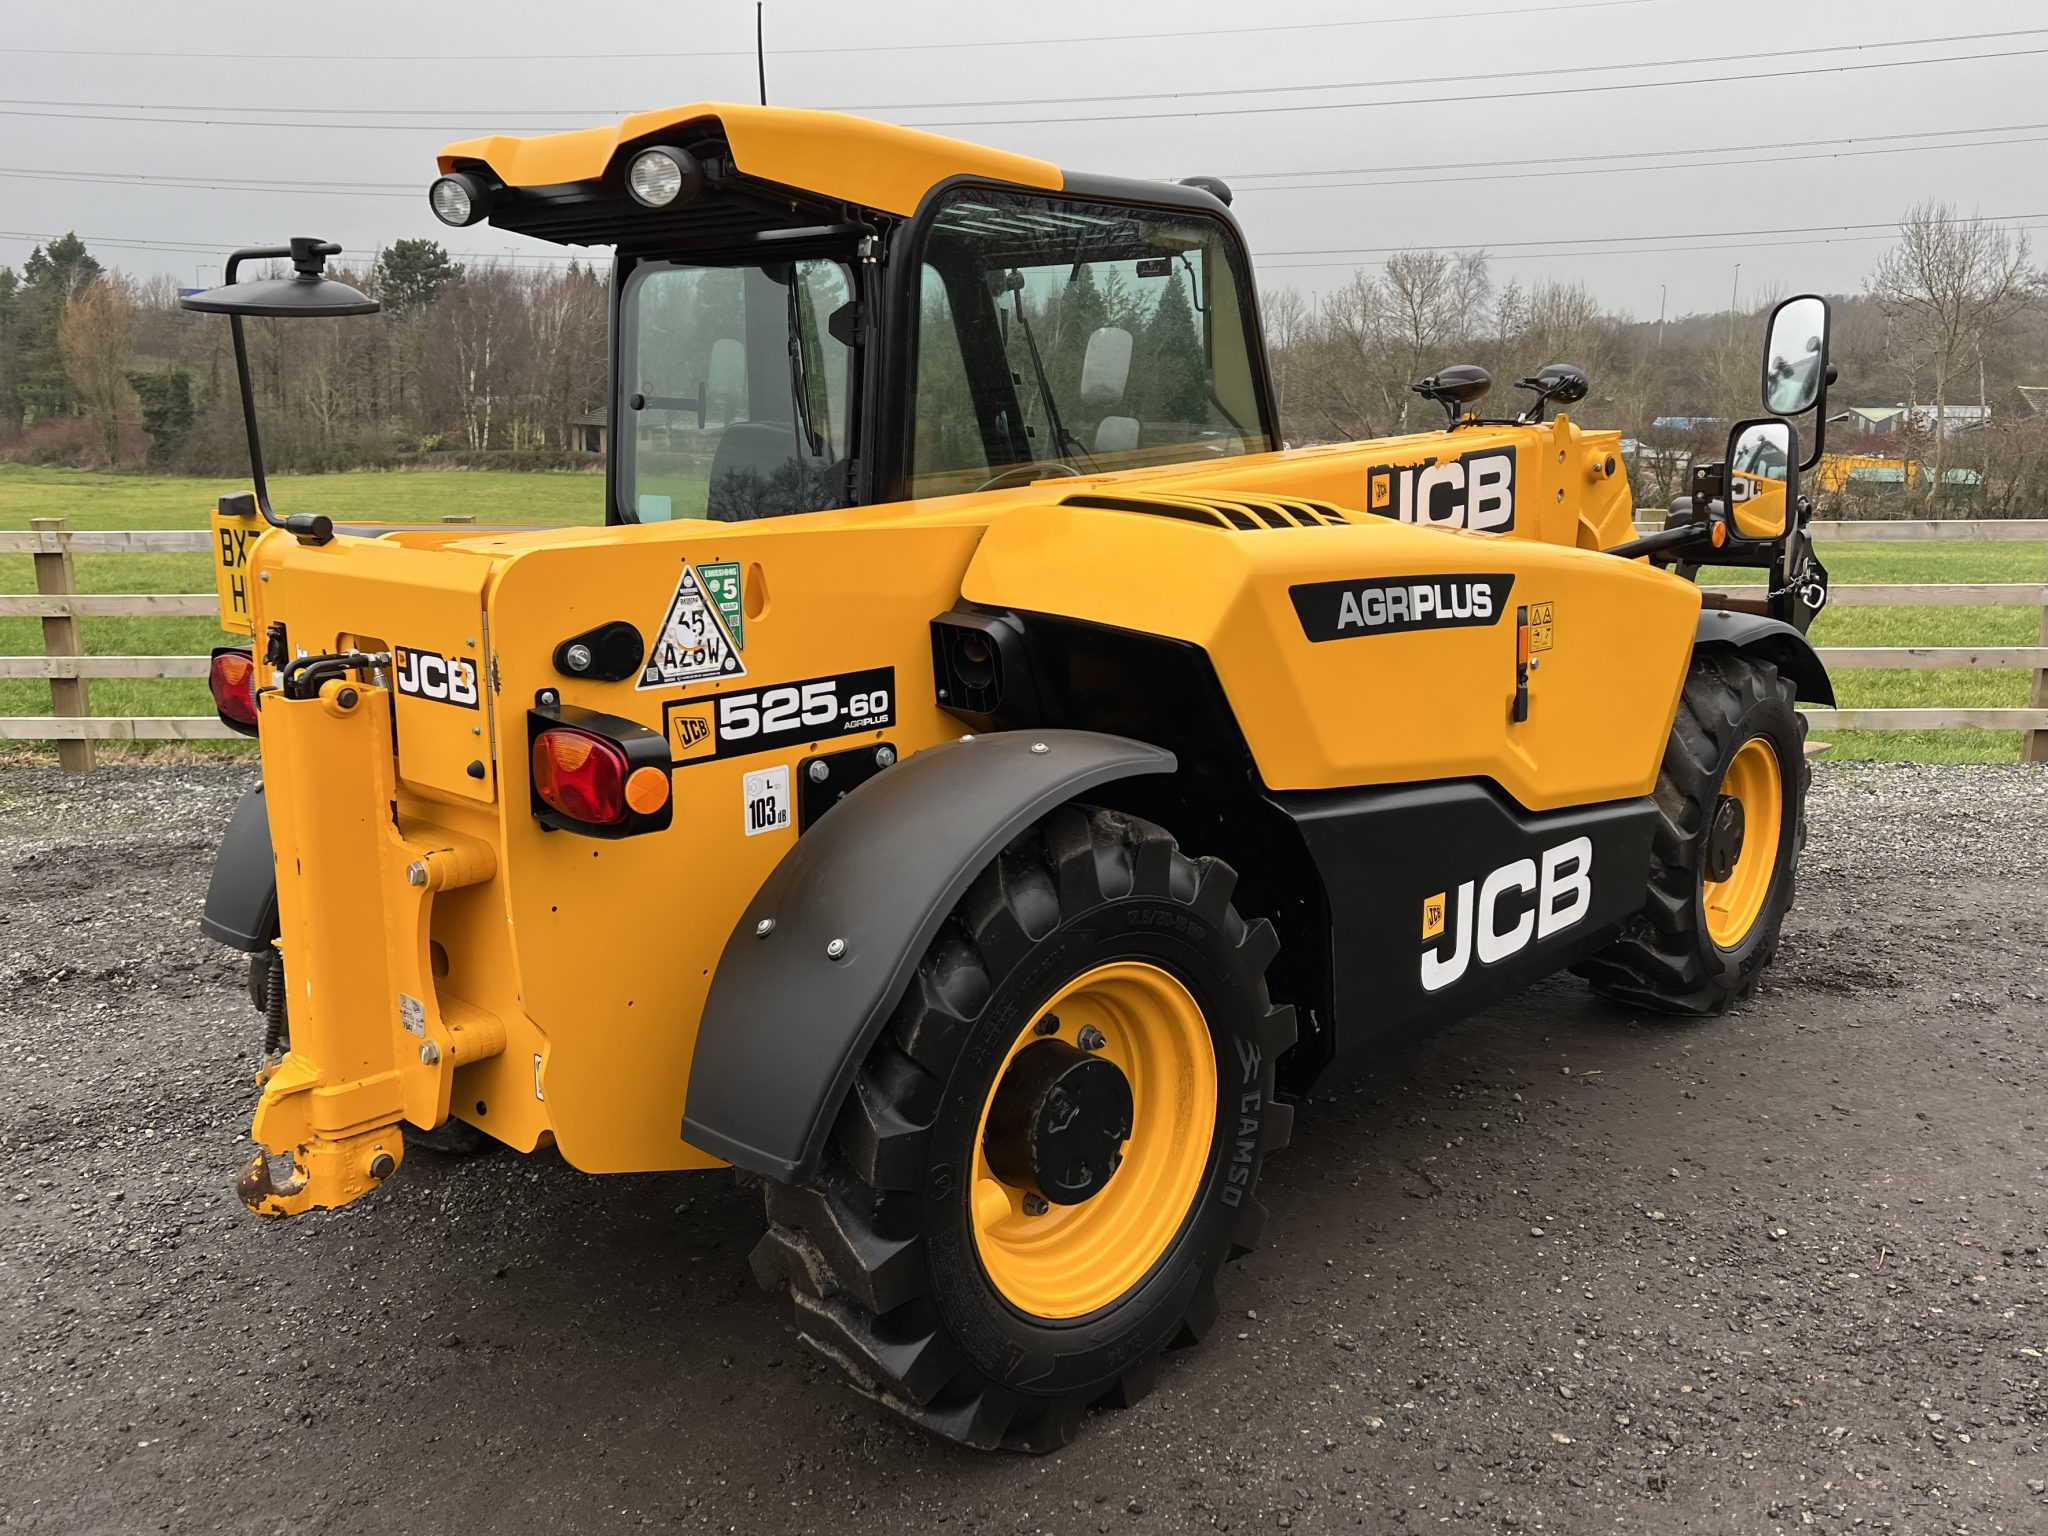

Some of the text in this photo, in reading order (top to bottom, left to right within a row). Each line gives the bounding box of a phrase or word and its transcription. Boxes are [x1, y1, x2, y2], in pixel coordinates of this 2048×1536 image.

[722, 578, 738, 600] 5
[1337, 584, 1493, 630] AGRIPLUS
[398, 652, 477, 705] JCB
[681, 719, 708, 745] JCB
[843, 714, 889, 730] AGRIPLUS
[766, 779, 773, 789] L
[749, 795, 787, 829] 103 dB
[1421, 836, 1593, 991] JCB
[1220, 1093, 1262, 1208] CAMSO
